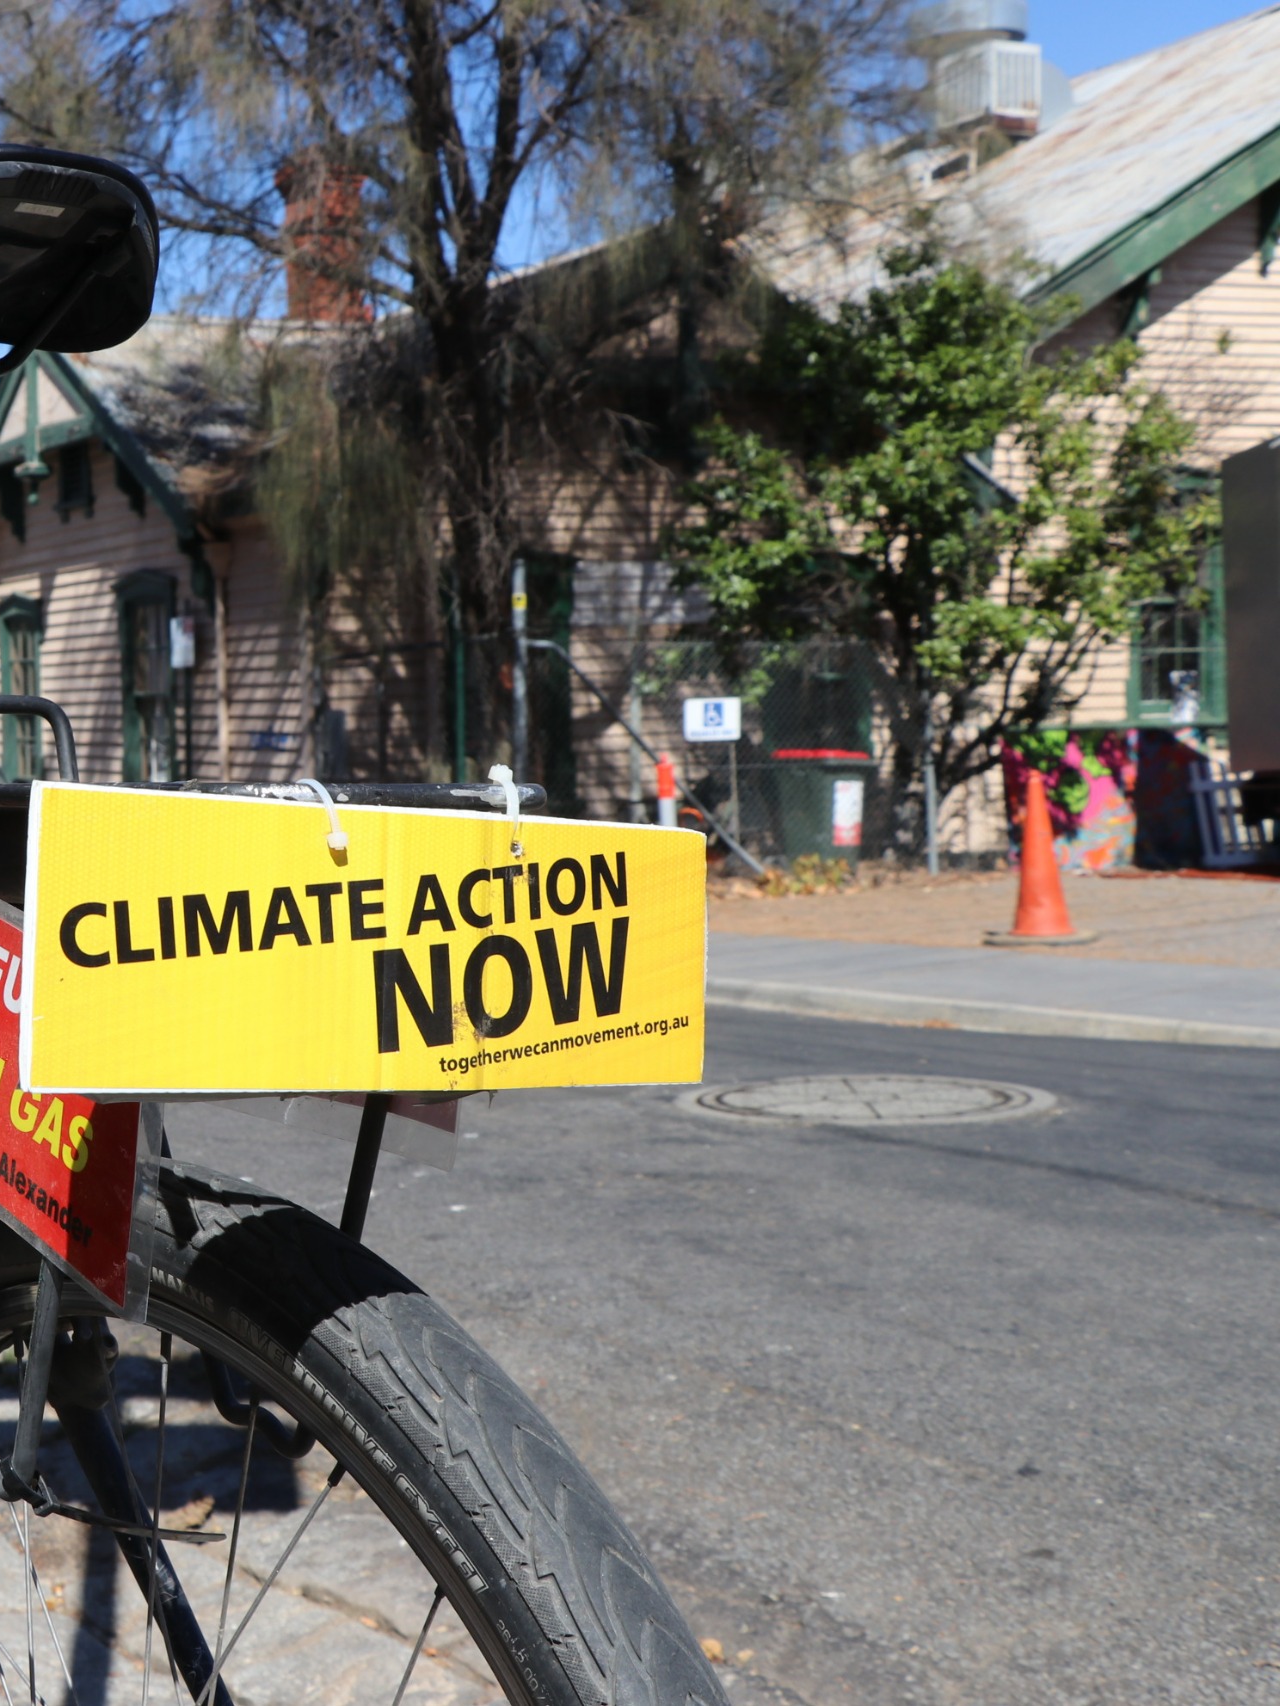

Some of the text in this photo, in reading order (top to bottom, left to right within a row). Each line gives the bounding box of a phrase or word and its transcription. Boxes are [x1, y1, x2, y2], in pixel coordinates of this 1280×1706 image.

[59, 851, 628, 968] CLIMATE ACTION
[372, 916, 629, 1055] NOW
[438, 1014, 690, 1075] togetherwecanmovement.org.au
[9, 1089, 94, 1173] GAS
